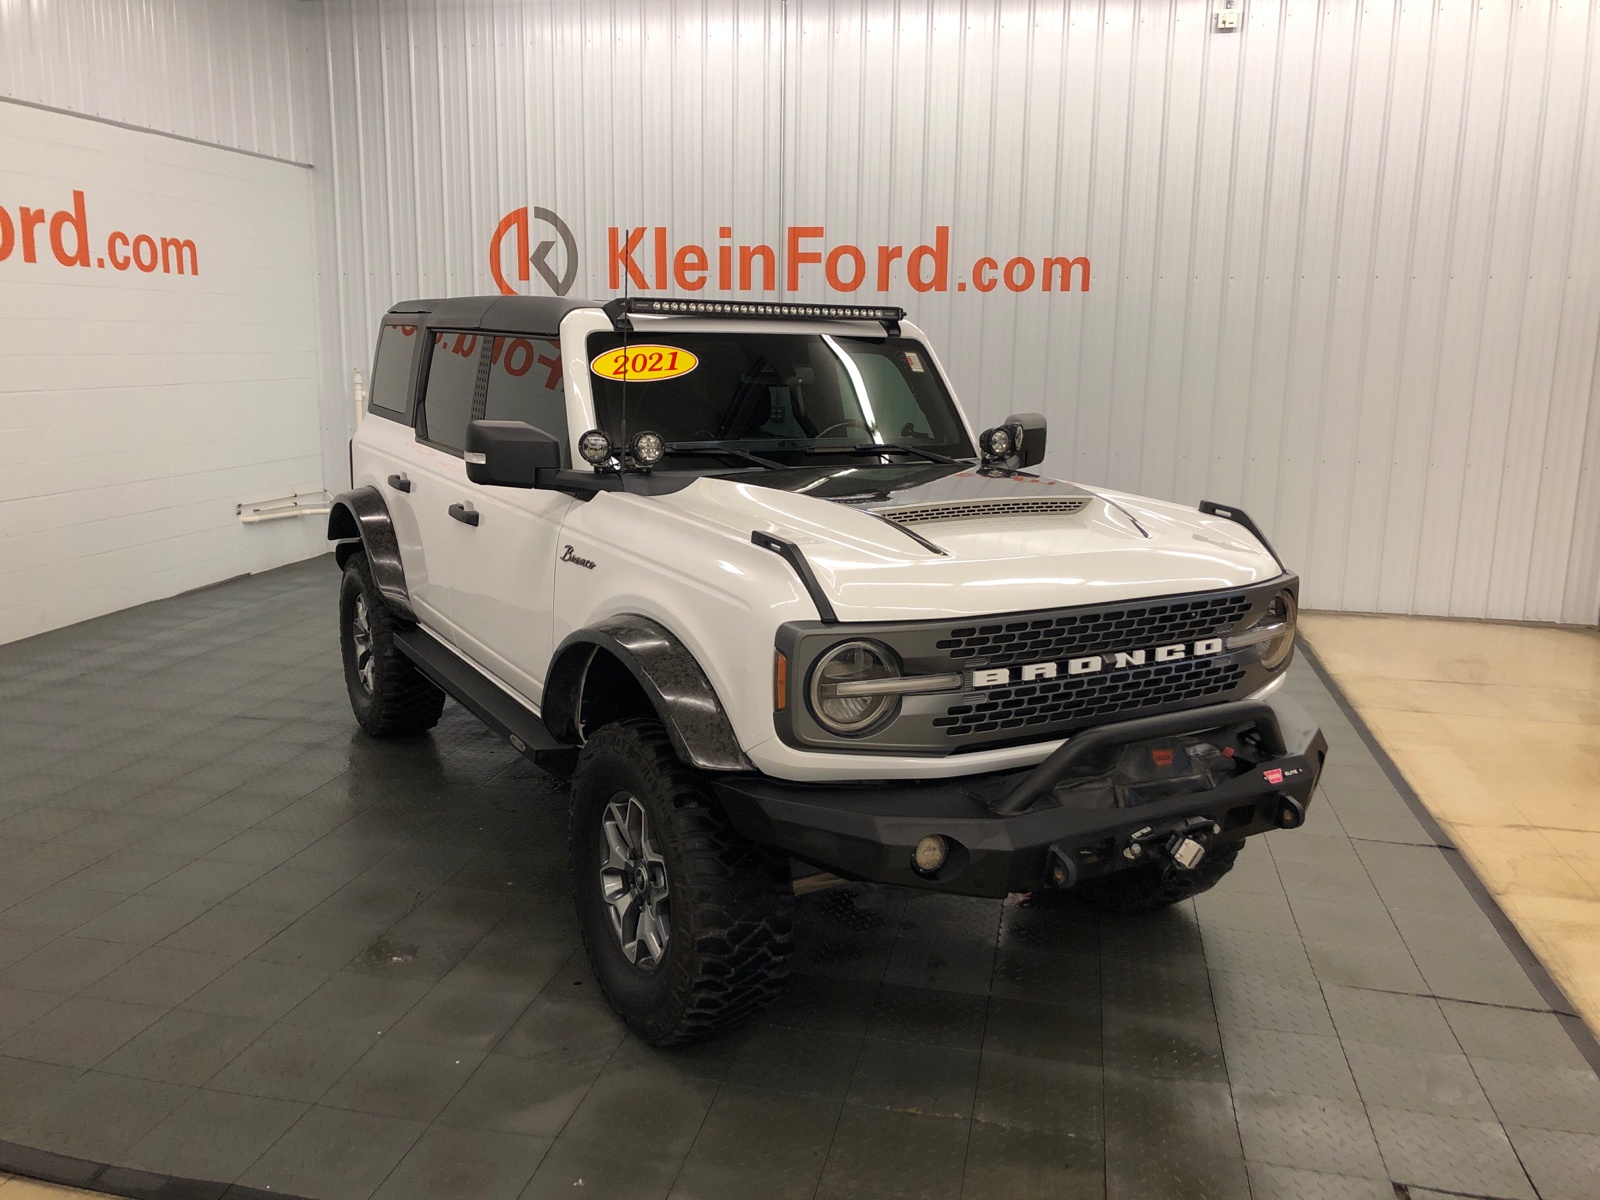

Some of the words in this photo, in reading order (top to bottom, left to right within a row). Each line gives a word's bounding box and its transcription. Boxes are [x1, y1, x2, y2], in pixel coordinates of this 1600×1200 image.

[608, 225, 1091, 293] KleinFord.com
[612, 351, 678, 375] 2021
[560, 544, 597, 570] Bronco
[972, 637, 1223, 688] BRONCO
